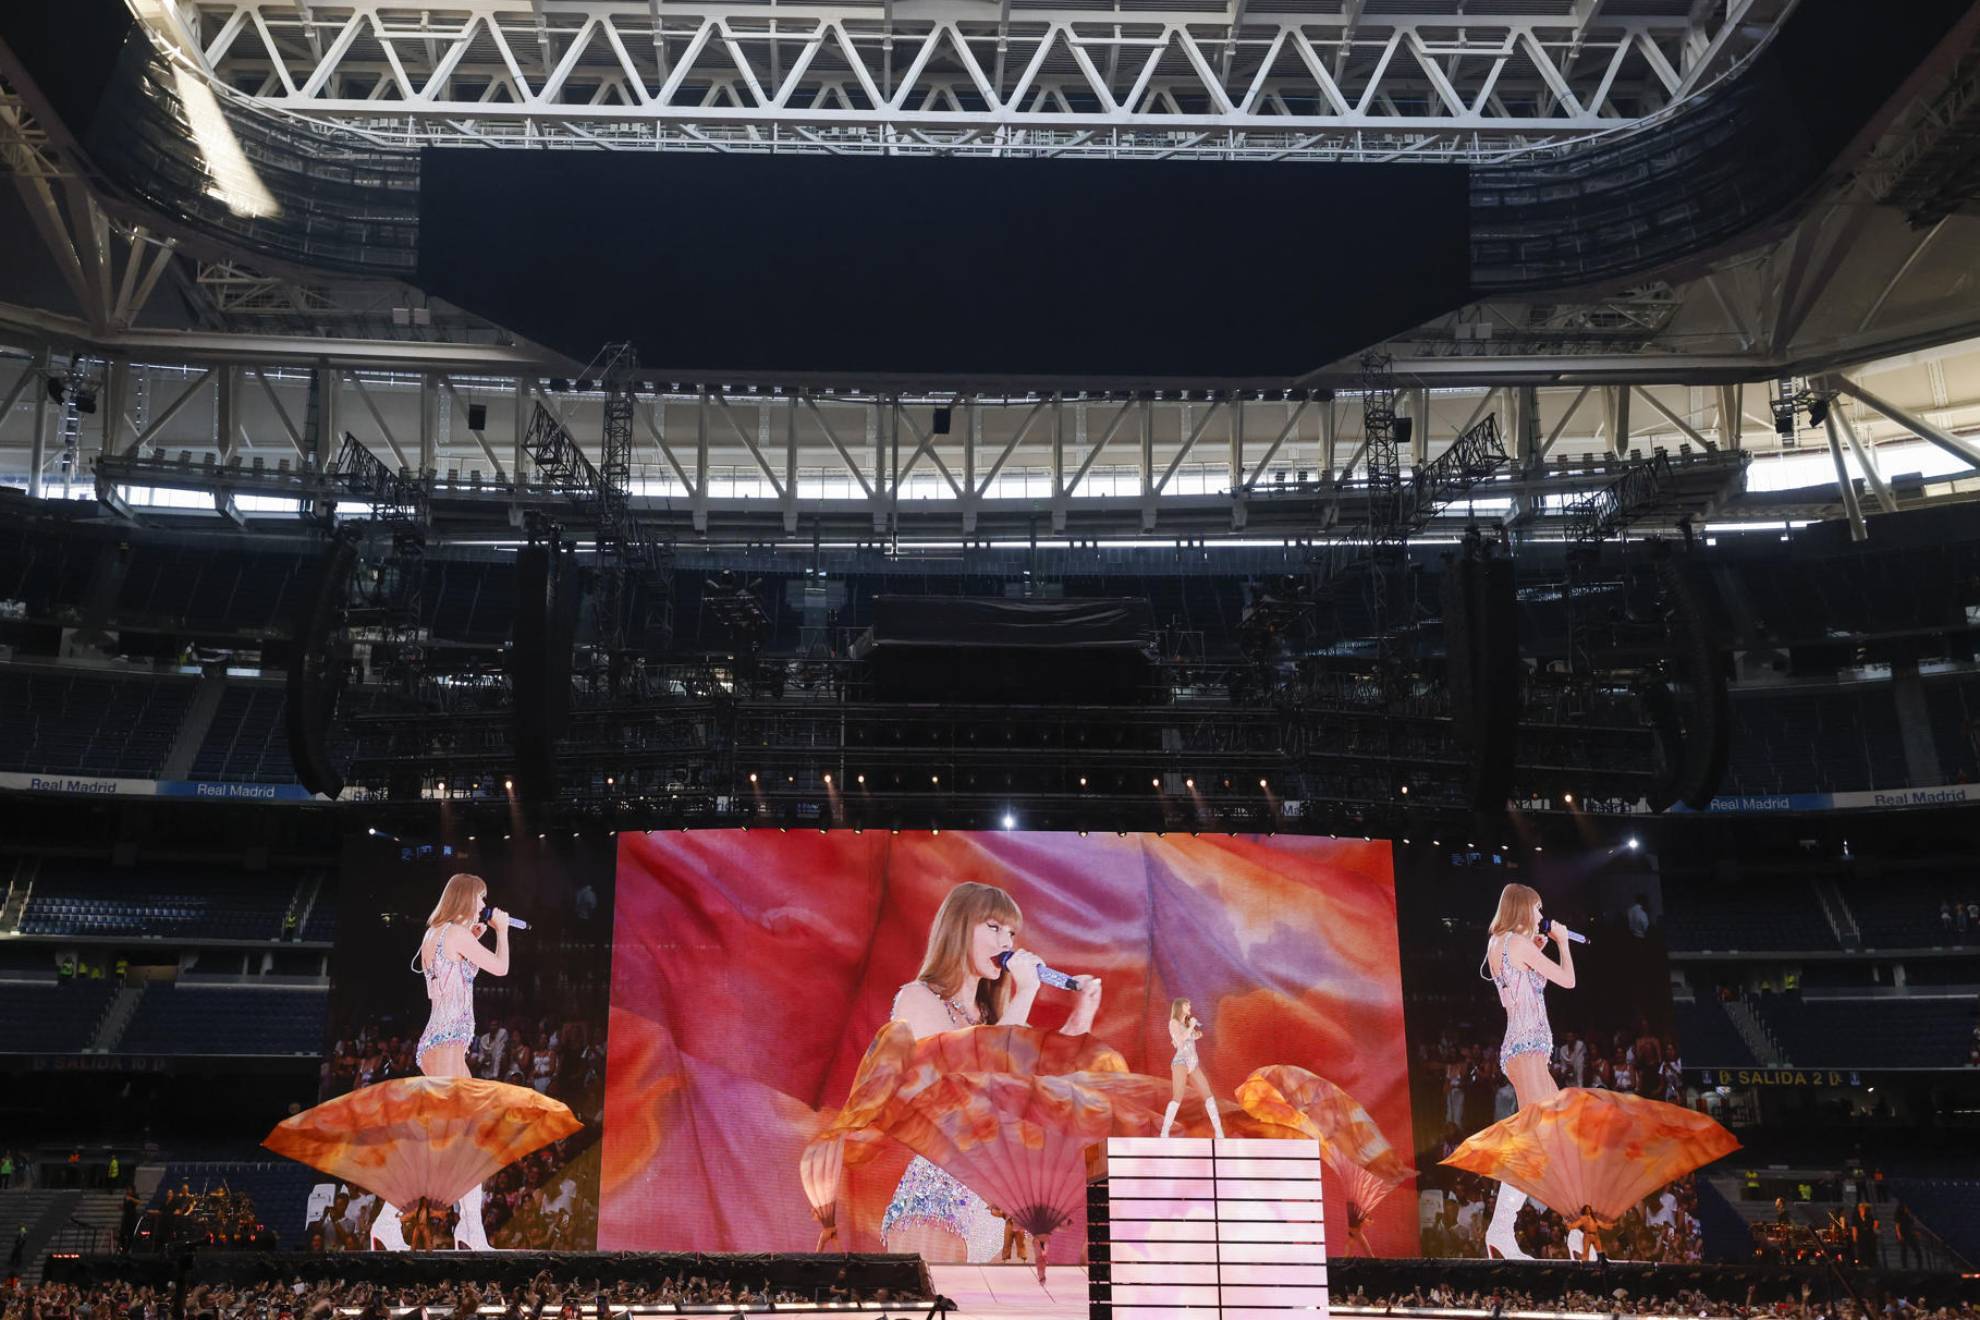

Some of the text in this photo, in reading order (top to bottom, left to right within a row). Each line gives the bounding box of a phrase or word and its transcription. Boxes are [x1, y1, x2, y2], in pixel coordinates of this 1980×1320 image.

[31, 778, 117, 794] Real Madrid
[197, 783, 275, 799] Real Madrid
[1710, 797, 1790, 810] Real Madrid
[1875, 789, 1967, 807] Real Madrid
[1738, 1072, 1823, 1086] SALIDA 2
